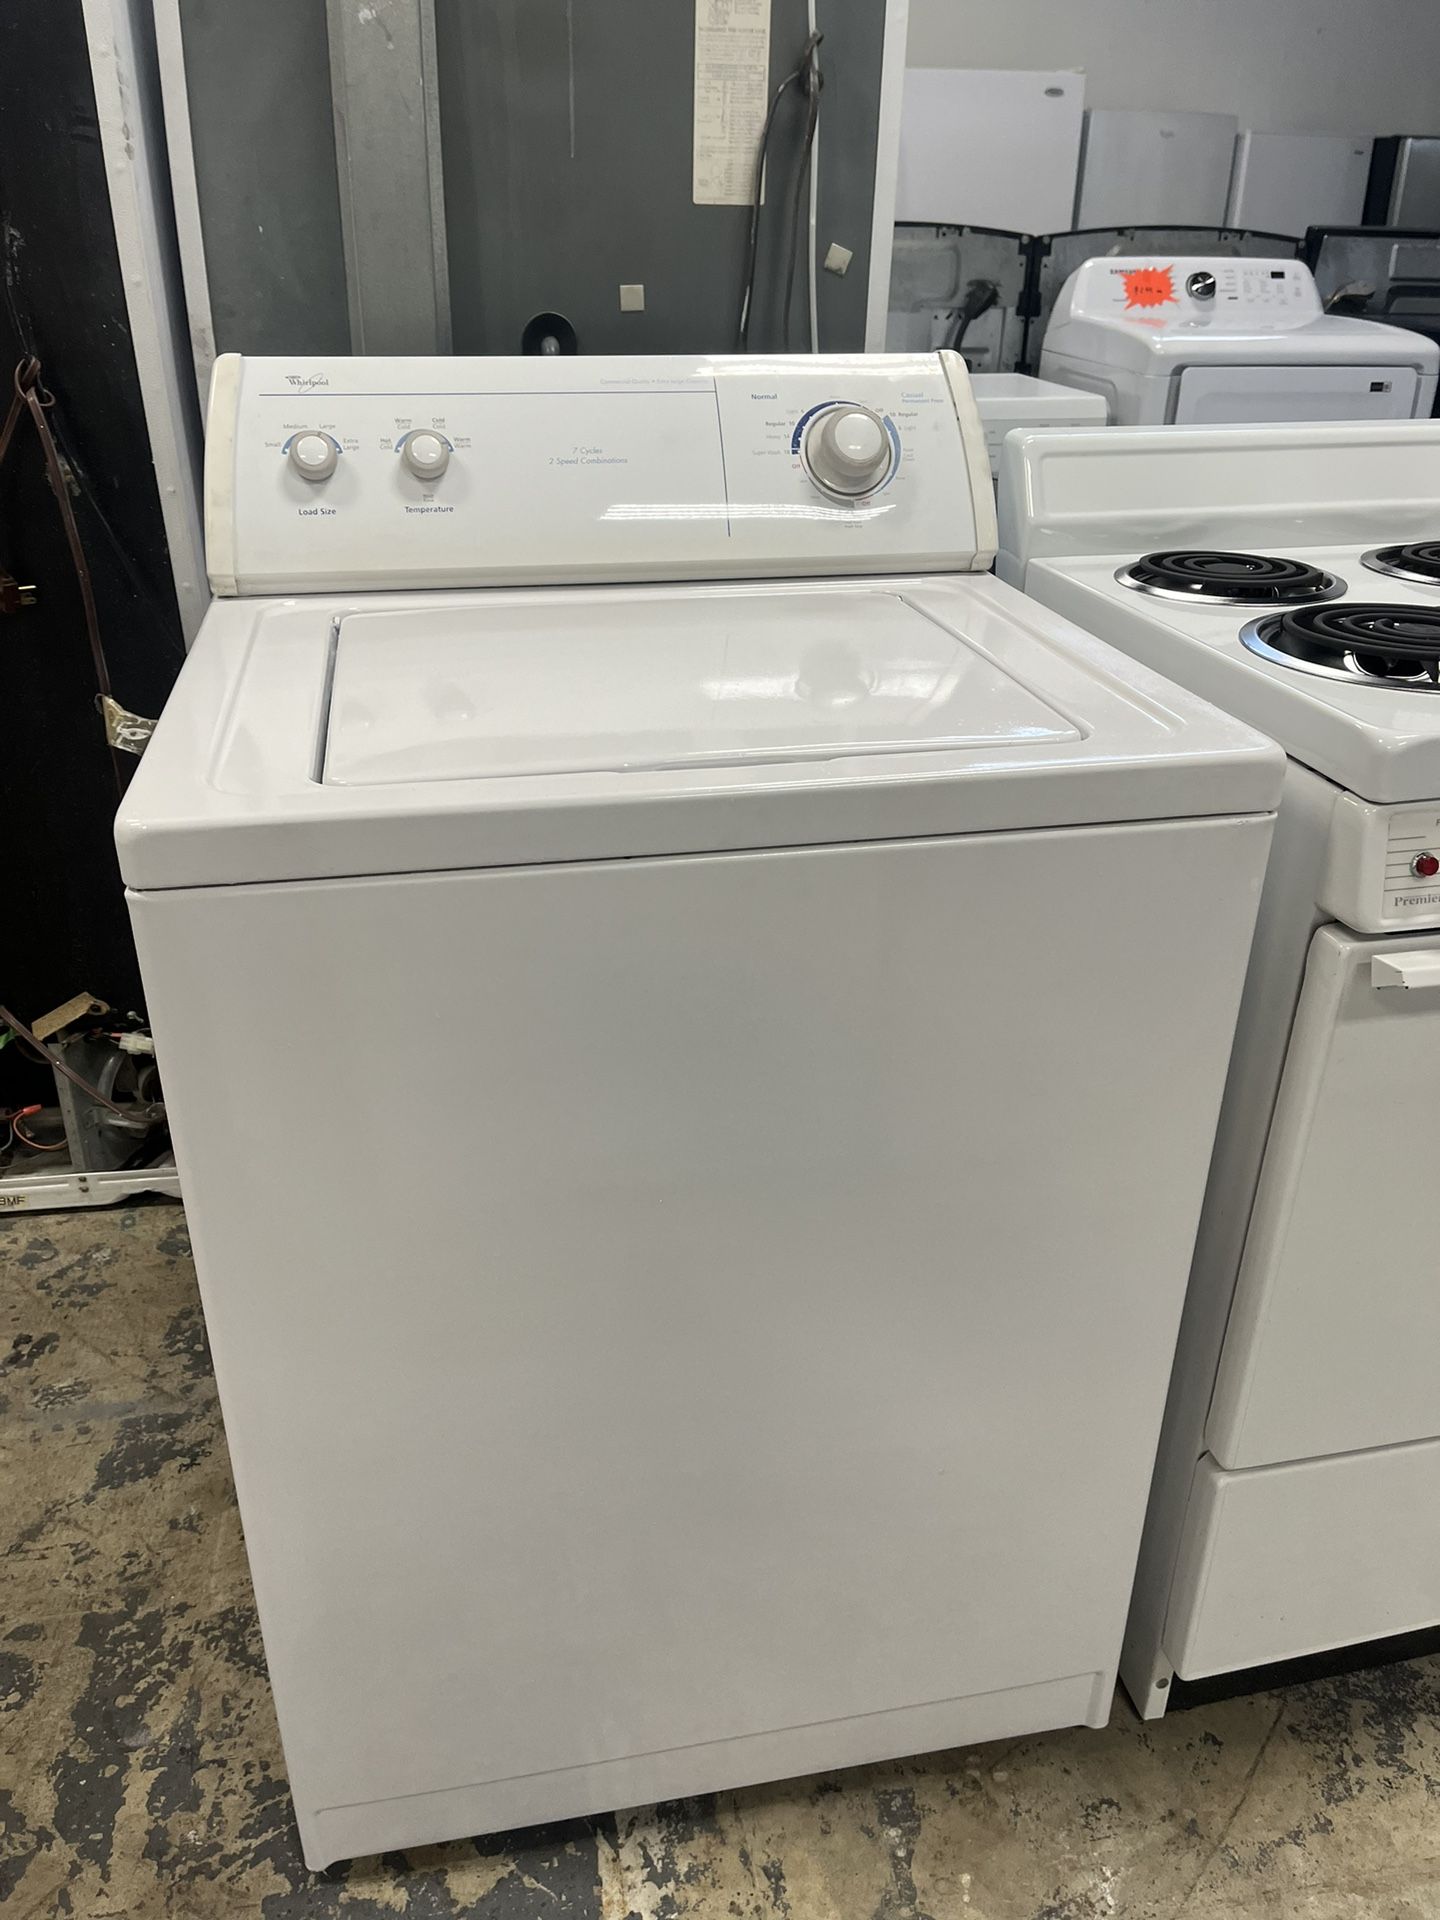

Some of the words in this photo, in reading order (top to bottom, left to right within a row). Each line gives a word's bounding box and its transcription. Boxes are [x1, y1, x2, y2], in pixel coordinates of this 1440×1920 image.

[285, 374, 329, 389] Whirlpool
[319, 423, 336, 431] Large
[571, 446, 578, 455] 7
[580, 447, 603, 456] Cycles
[548, 457, 554, 465] 2
[556, 457, 579, 467] Speed
[580, 457, 628, 465] Combinations
[298, 508, 318, 516] Load
[320, 507, 337, 516] Size
[404, 505, 454, 514] Temperature
